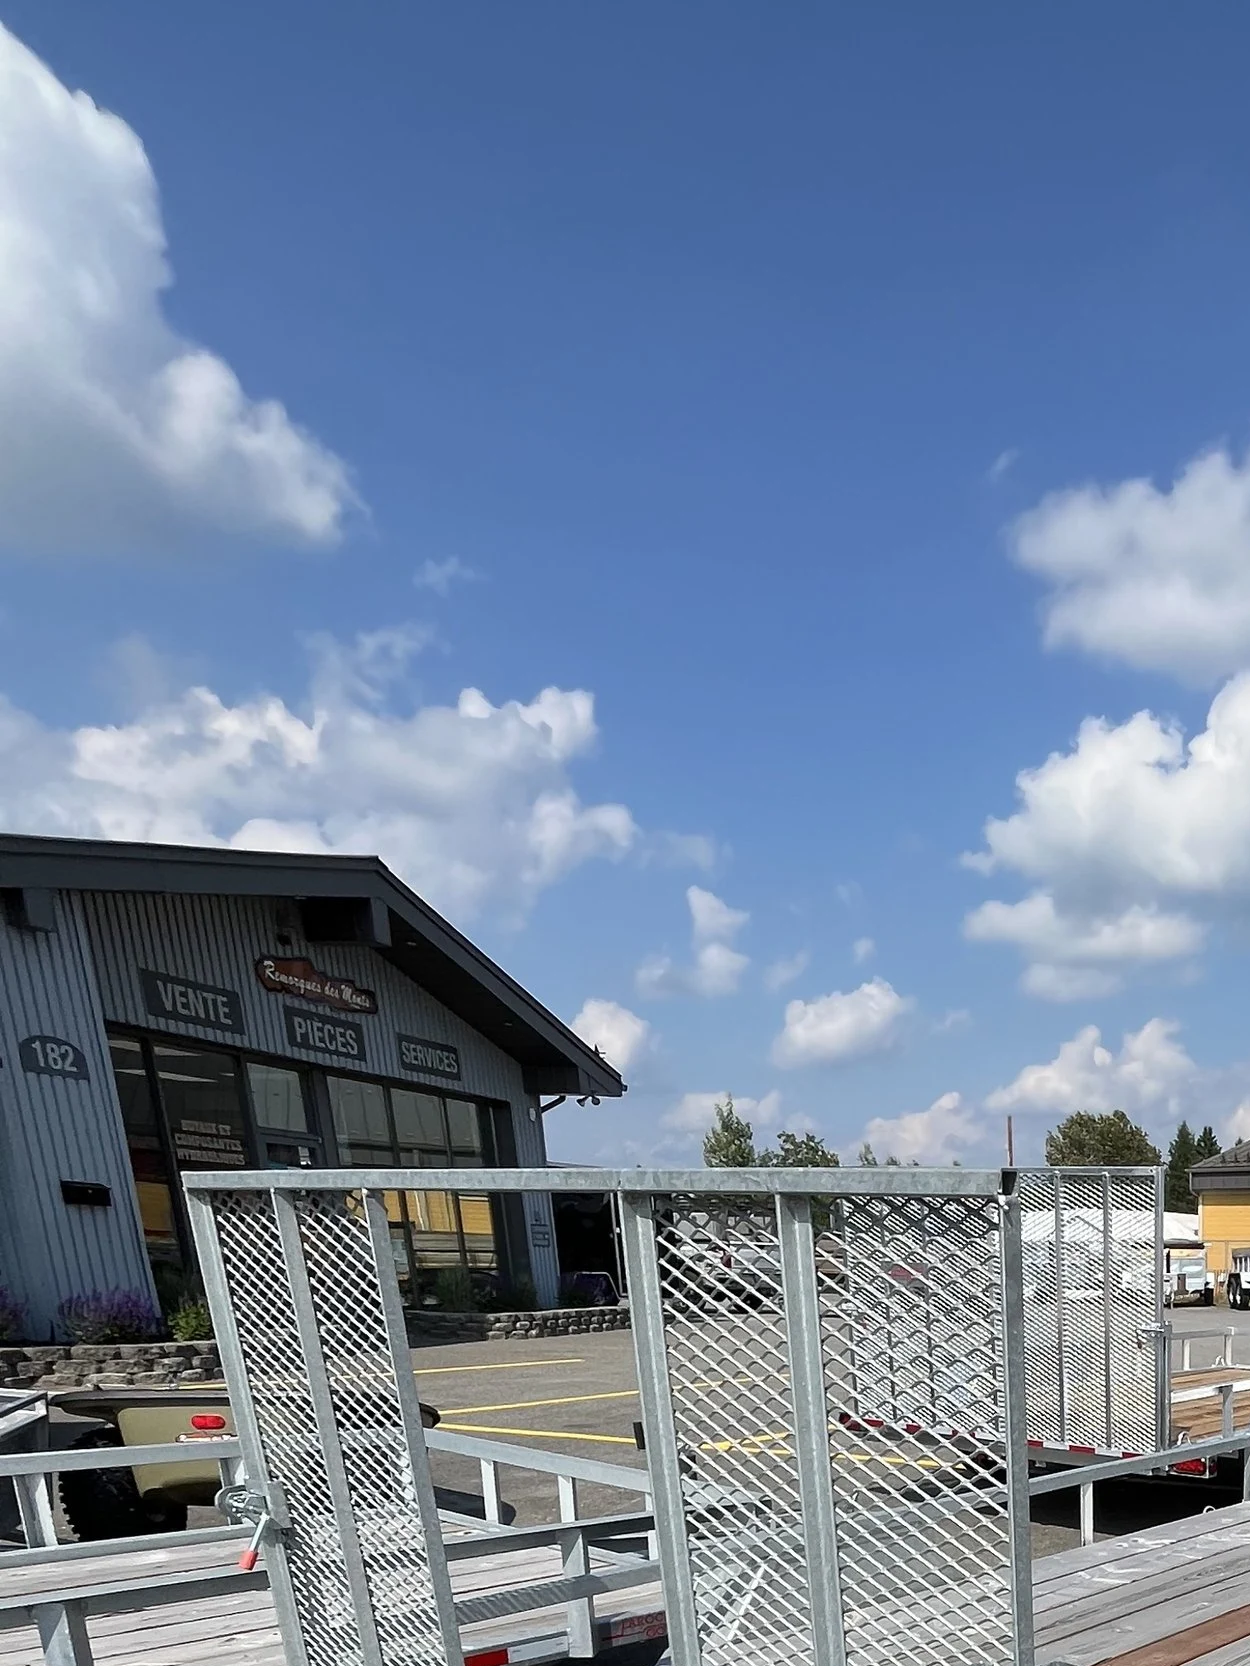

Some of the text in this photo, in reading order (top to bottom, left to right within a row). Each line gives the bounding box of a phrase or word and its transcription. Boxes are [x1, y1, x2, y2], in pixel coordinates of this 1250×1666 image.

[157, 980, 233, 1026] VENTE
[263, 960, 370, 1009] Remorques des Monts
[293, 1016, 358, 1055] PIÈCES
[31, 1040, 79, 1072] 182
[403, 1041, 458, 1075] SERVICES
